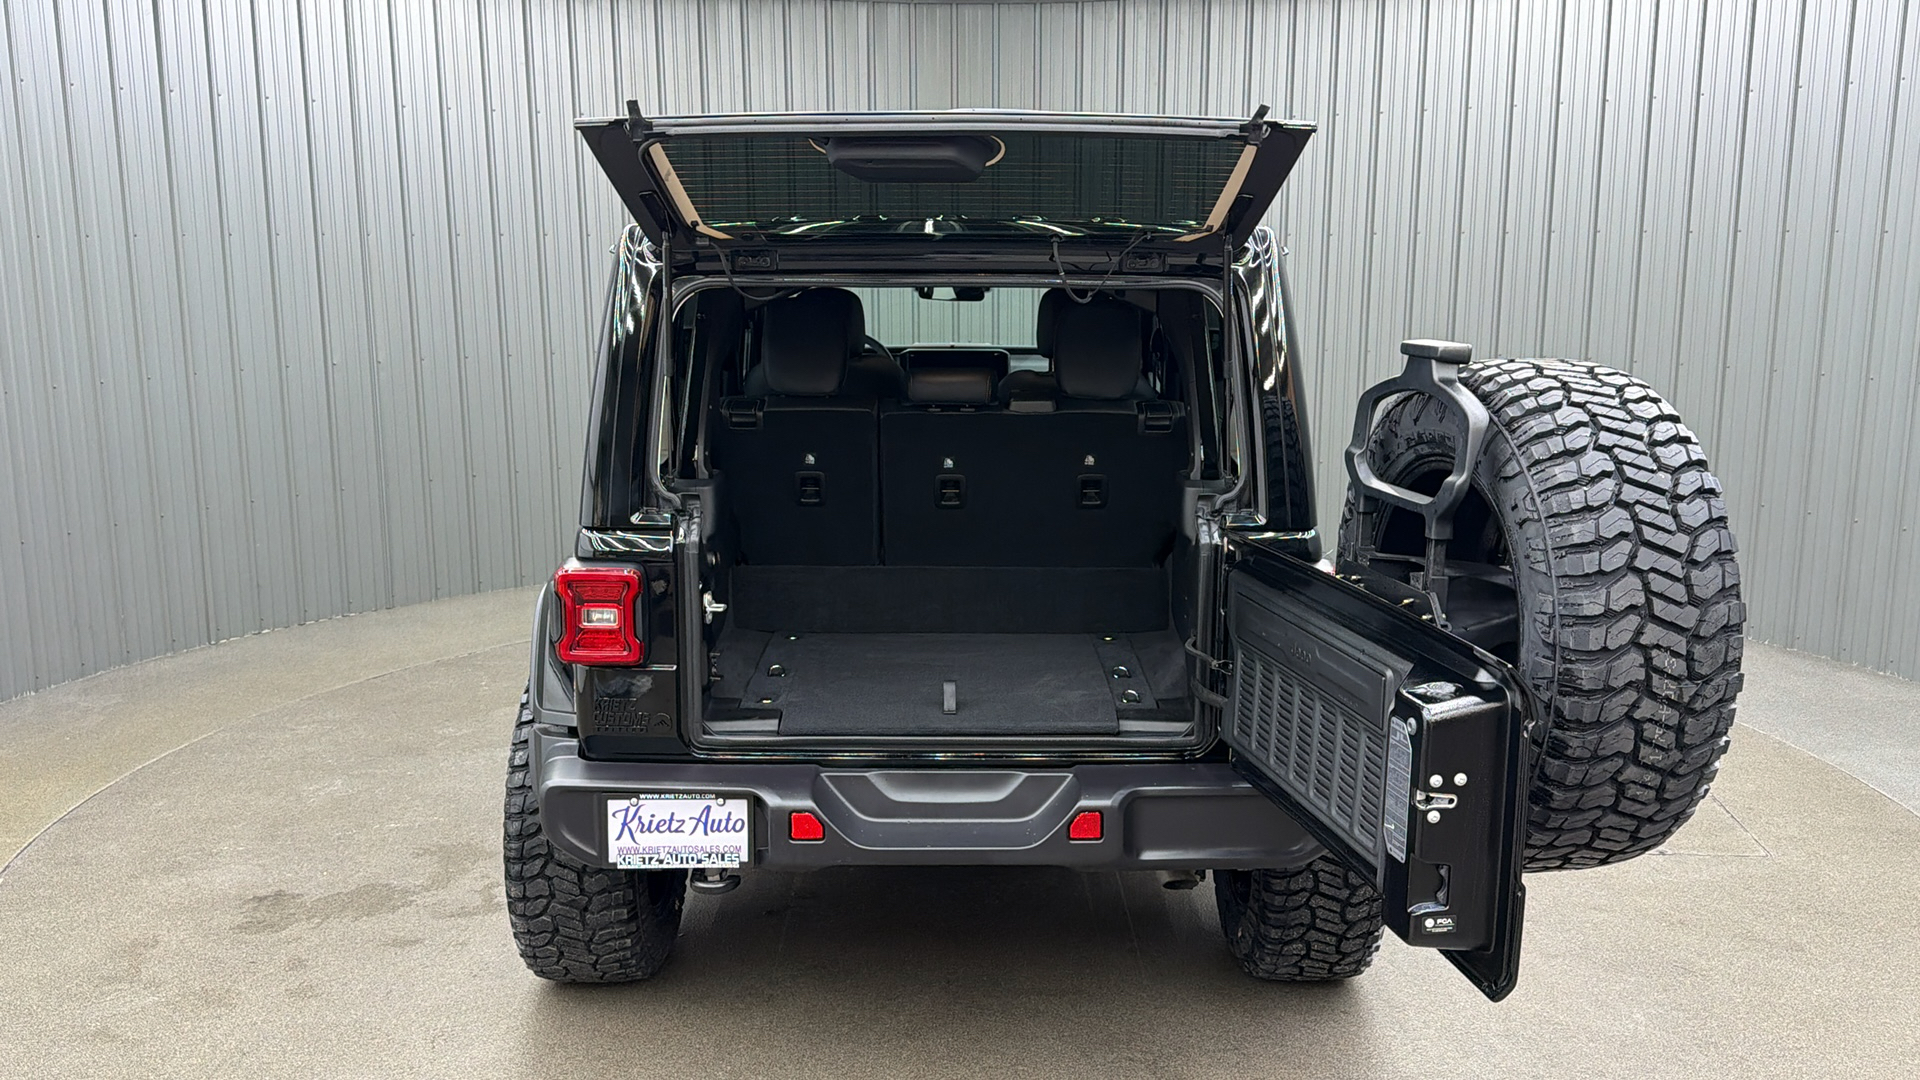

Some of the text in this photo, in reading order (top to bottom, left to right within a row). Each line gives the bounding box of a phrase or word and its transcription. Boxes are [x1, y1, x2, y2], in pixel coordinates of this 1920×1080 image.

[594, 697, 638, 711] KRIETZ
[593, 711, 651, 727] CUSTOMS
[612, 803, 745, 846] Krietz Auto
[617, 845, 742, 854] WWW.KRIETZAUTOSALES.COM
[617, 853, 740, 866] KRIETZ AUTO SALES
[1436, 917, 1453, 925] FCA
